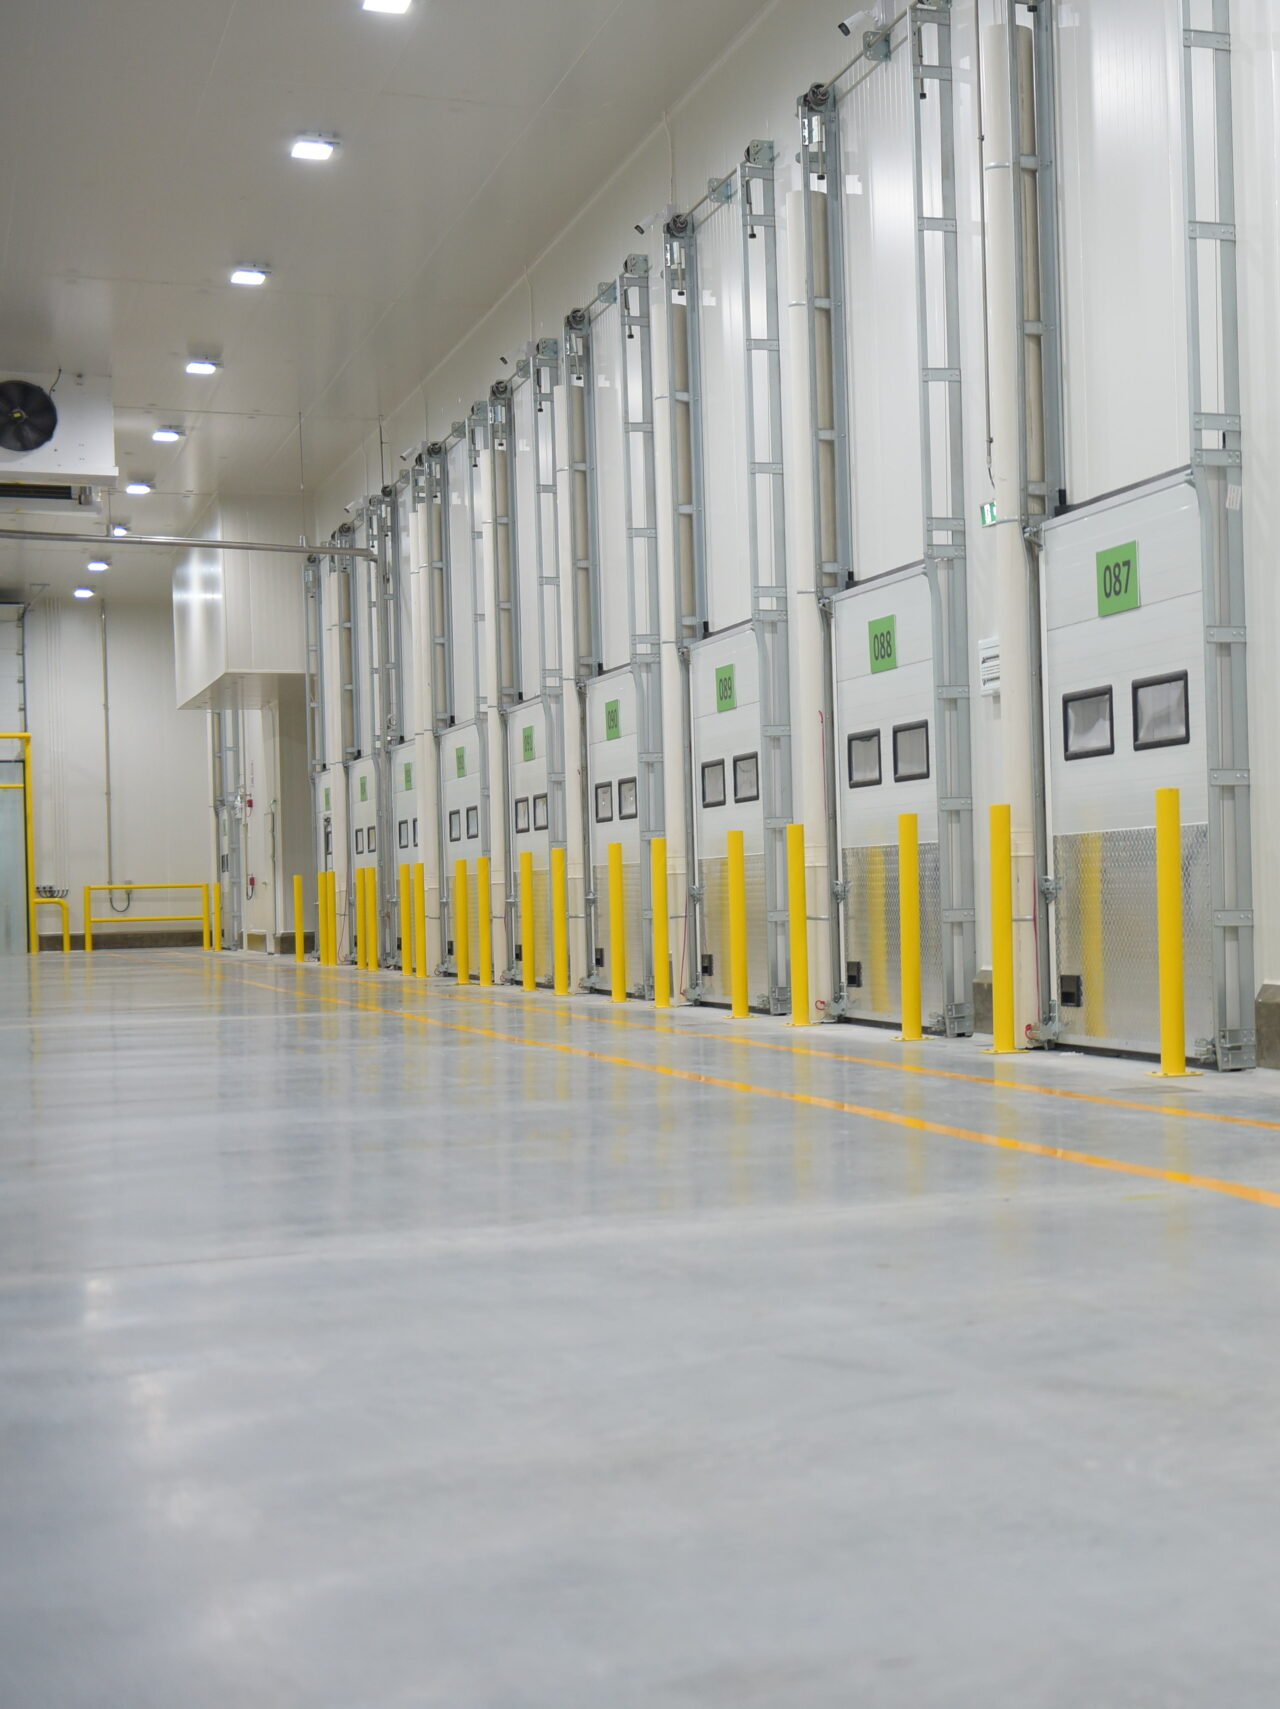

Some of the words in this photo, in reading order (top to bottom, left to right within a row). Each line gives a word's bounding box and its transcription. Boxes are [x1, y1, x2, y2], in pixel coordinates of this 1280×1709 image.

[1103, 559, 1131, 599] 087
[873, 630, 892, 661] 088
[718, 676, 733, 701] 089
